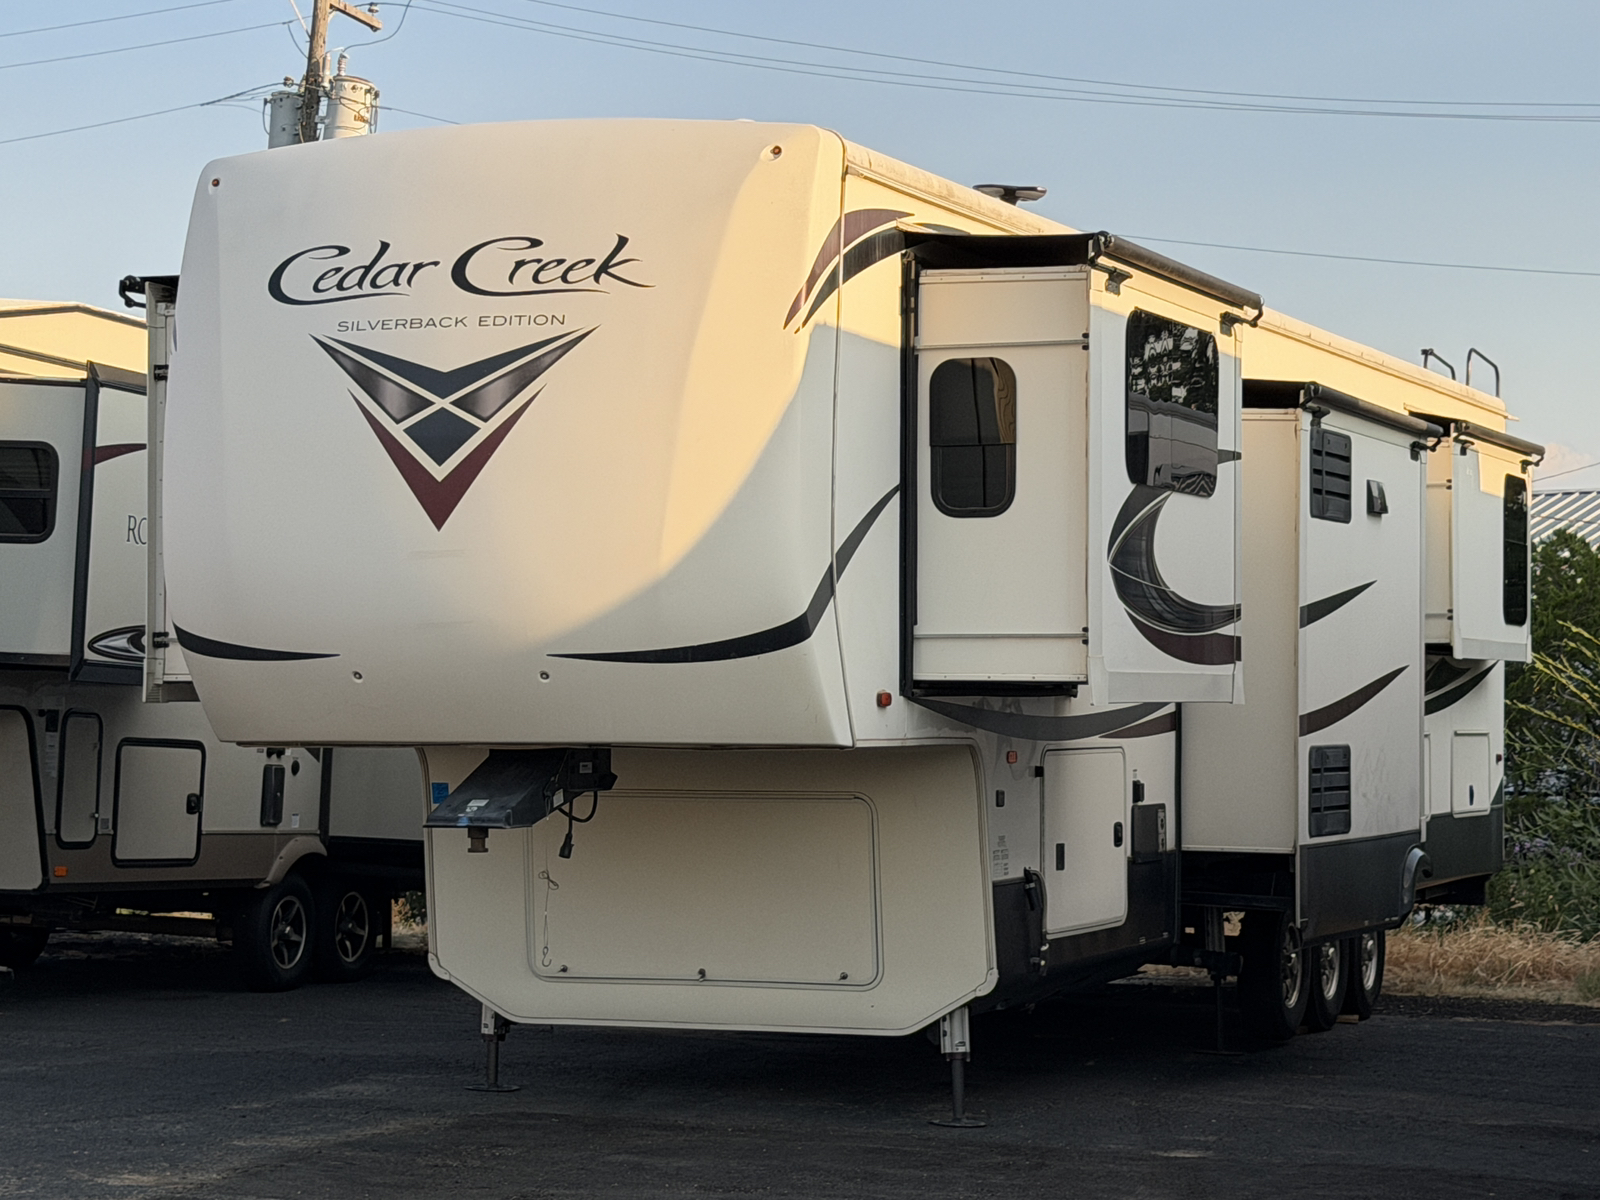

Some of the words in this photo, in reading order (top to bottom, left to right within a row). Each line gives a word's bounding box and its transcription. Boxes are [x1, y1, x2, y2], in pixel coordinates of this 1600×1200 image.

[268, 239, 441, 306] Cedar
[450, 233, 656, 297] Creek
[336, 315, 469, 333] SILVERBACK
[477, 313, 566, 328] EDITION
